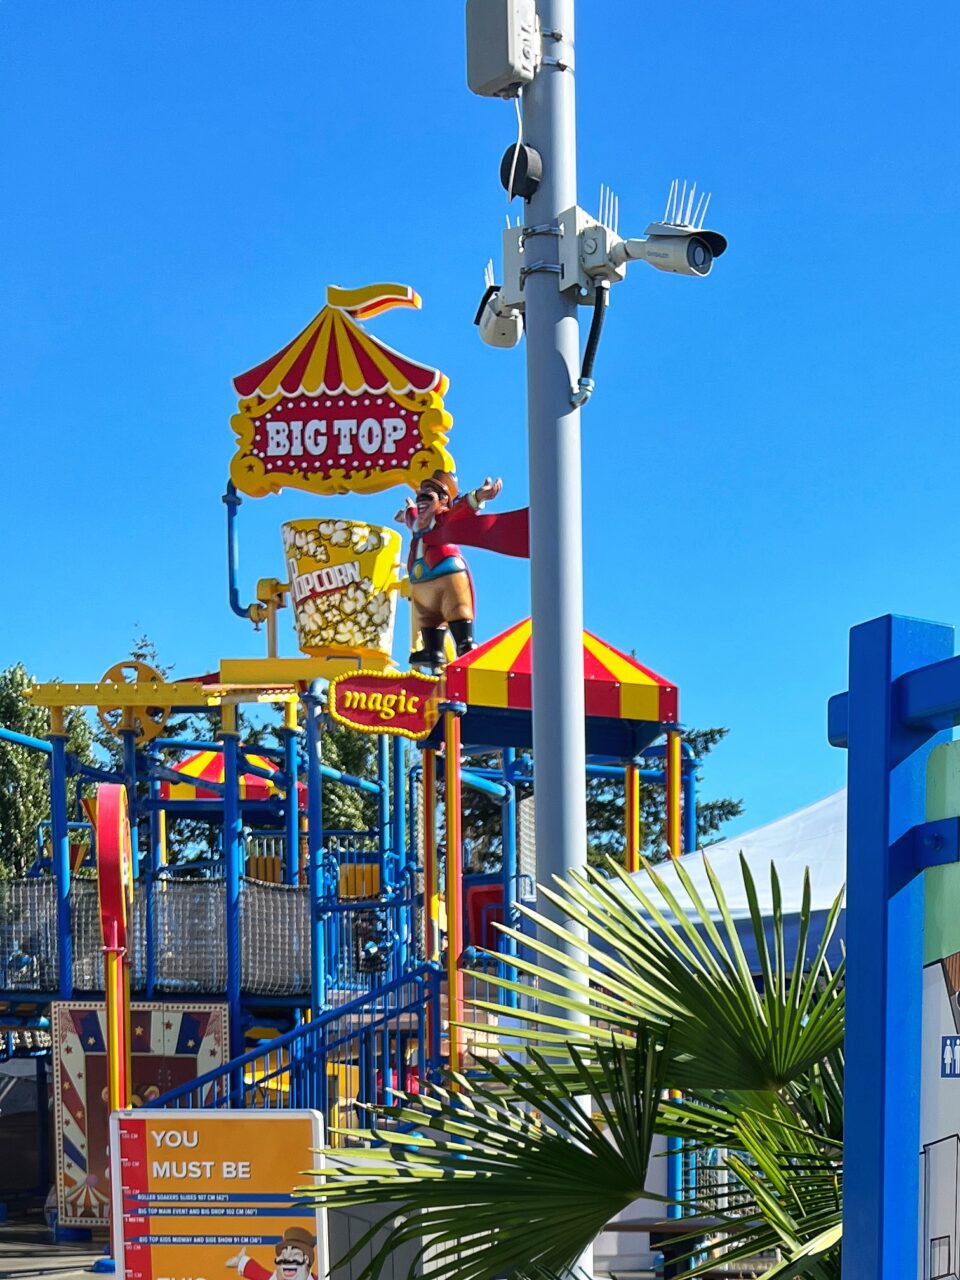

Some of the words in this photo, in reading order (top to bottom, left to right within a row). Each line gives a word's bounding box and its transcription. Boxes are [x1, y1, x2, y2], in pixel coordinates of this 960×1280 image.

[266, 420, 328, 456] BIG
[333, 418, 407, 455] TOP
[289, 558, 362, 602] POPCORN
[344, 688, 420, 720] magic
[151, 1130, 199, 1149] YOU
[152, 1161, 214, 1179] MUST
[222, 1161, 251, 1179] BE
[149, 1236, 159, 1244] TOP
[193, 1236, 204, 1244] AND
